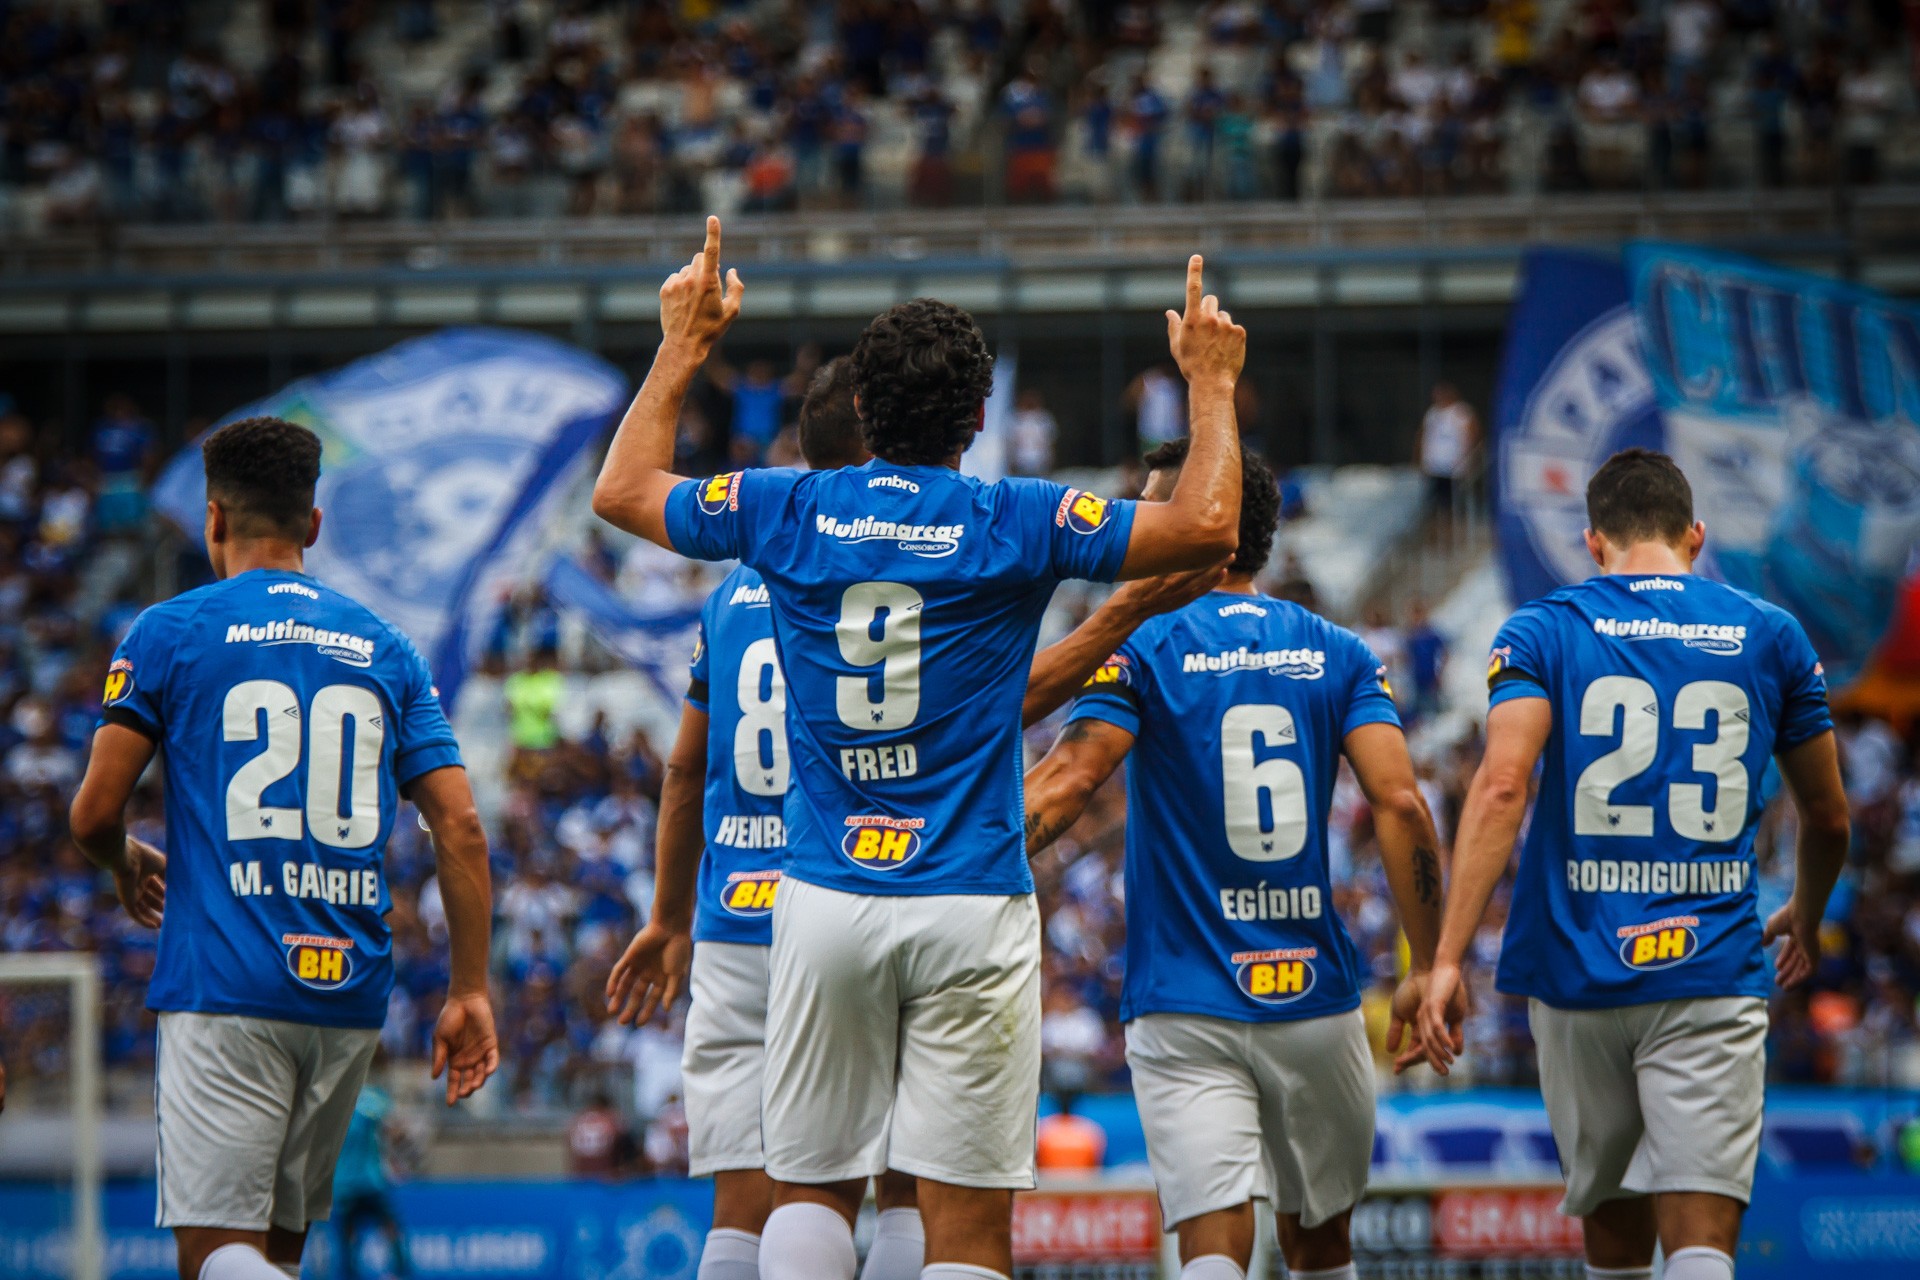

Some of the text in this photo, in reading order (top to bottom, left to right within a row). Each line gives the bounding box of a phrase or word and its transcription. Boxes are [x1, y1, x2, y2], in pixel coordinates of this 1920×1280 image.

[868, 475, 920, 494] umbro
[816, 514, 965, 542] Multimarcas
[267, 582, 319, 600] umbro
[1629, 577, 1685, 592] umbro
[225, 618, 375, 654] Multimarcas
[1594, 618, 1747, 640] Multimarcas
[834, 581, 924, 731] 9
[1183, 646, 1326, 673] Multimarcas
[734, 637, 791, 796] 8
[222, 679, 384, 849] 20
[840, 743, 917, 781] FRED
[1574, 675, 1750, 843] 23
[1220, 703, 1308, 863] 6
[852, 827, 911, 861] BH
[230, 861, 273, 896] M.
[1220, 880, 1321, 921] EGÍDIO
[298, 947, 343, 981] BH
[1632, 928, 1687, 965] BH
[1251, 961, 1304, 995] BH
